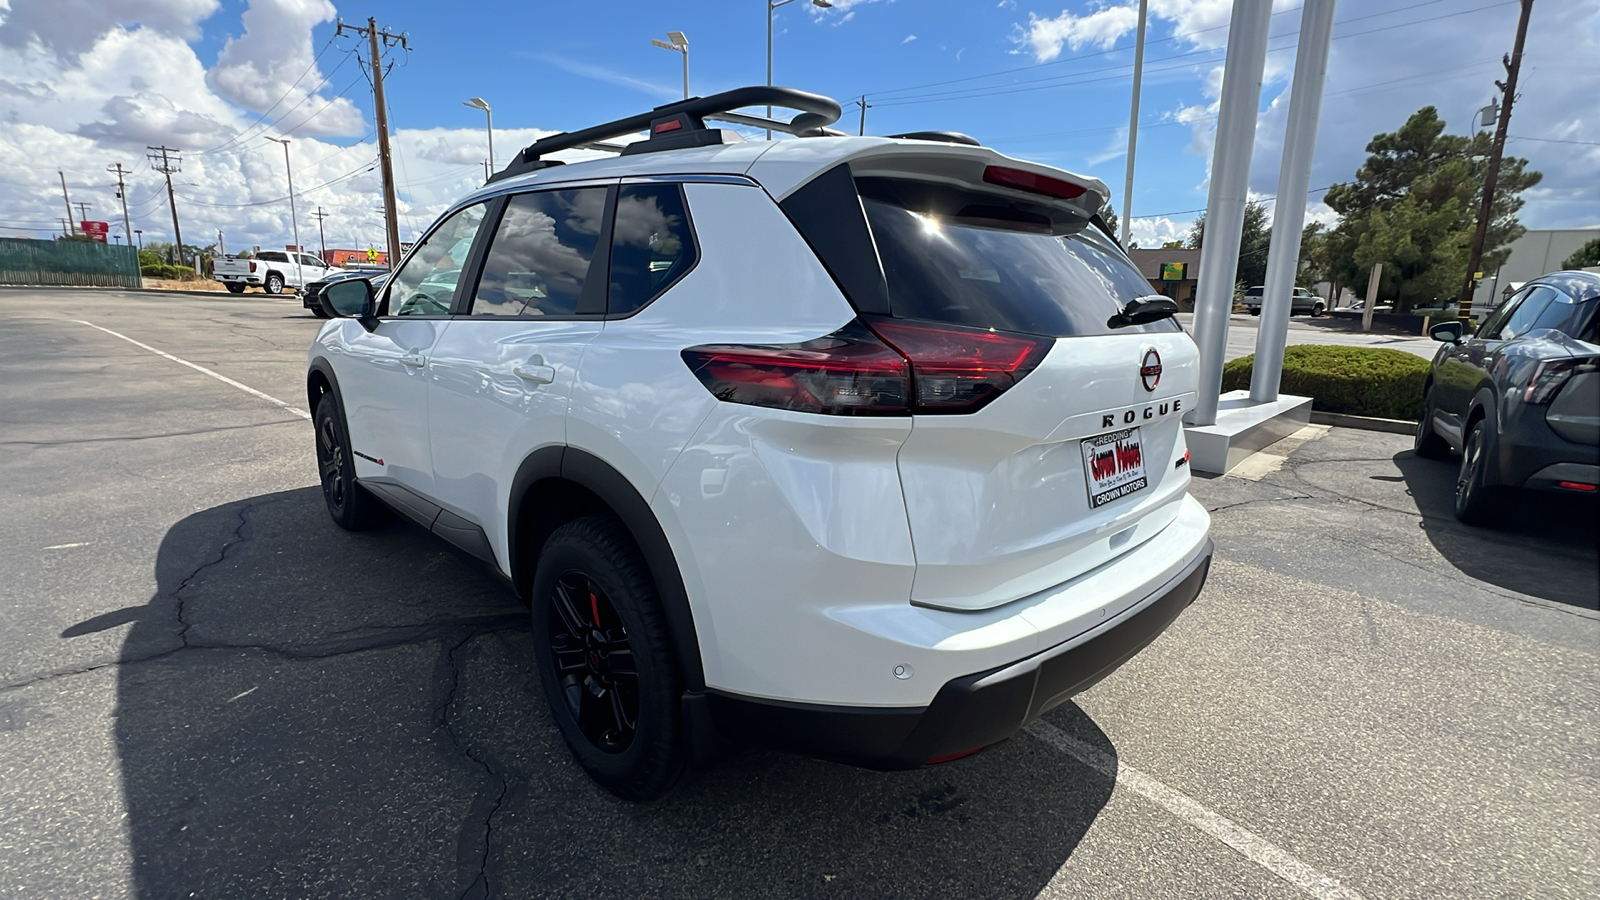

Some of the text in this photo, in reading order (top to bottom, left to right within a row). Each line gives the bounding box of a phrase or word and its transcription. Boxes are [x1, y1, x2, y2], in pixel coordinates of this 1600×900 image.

[1102, 399, 1181, 429] ROGUE
[1098, 430, 1129, 446] REDDING
[1096, 488, 1121, 506] CROWN
[1120, 479, 1146, 496] MOTORS
